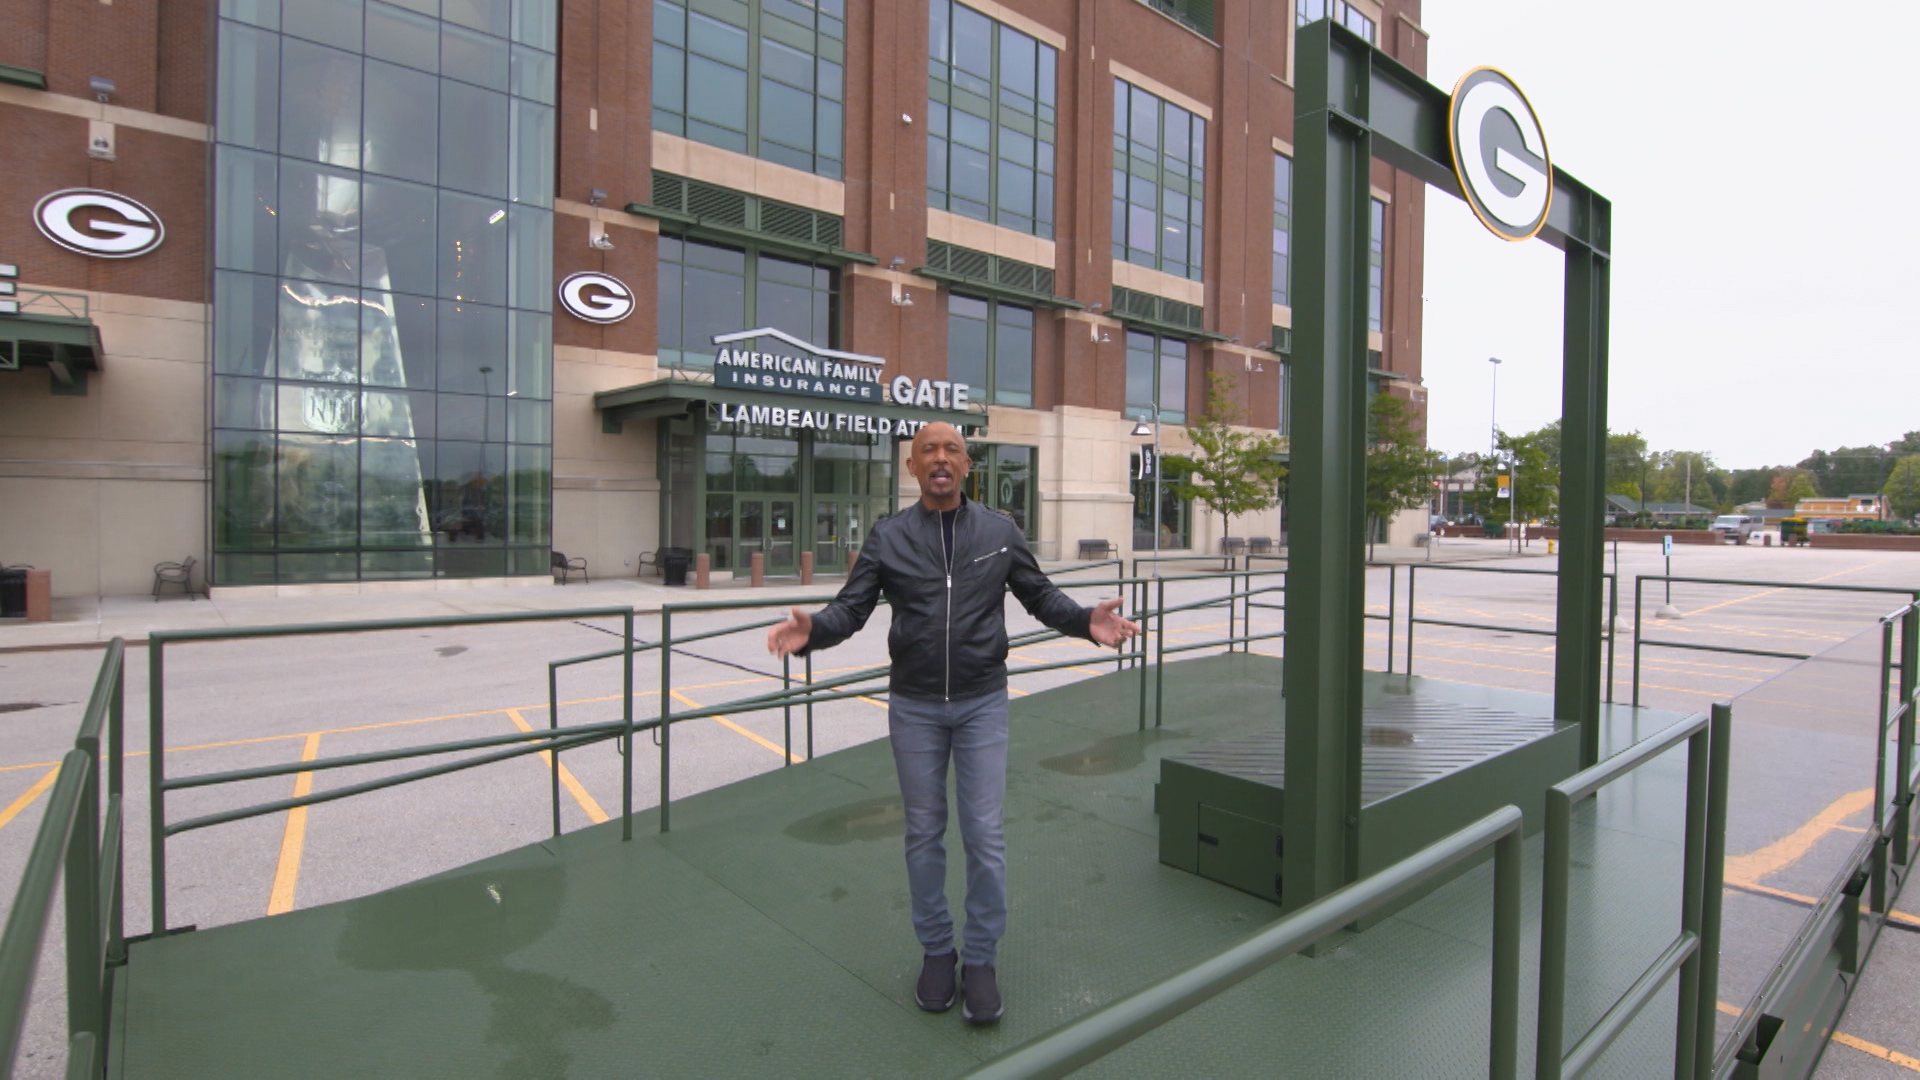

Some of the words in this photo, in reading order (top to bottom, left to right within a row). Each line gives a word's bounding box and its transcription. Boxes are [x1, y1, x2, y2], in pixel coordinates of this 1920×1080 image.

[1457, 80, 1548, 227] G
[42, 194, 156, 252] G
[564, 276, 630, 319] G
[717, 348, 816, 376] AMERICAN
[823, 361, 883, 384] FAMILY
[732, 371, 871, 398] INSURANCE
[891, 375, 969, 410] GATE
[721, 403, 829, 430] LAMBEAU
[836, 413, 892, 434] FIELD
[895, 419, 963, 437] ATRM
